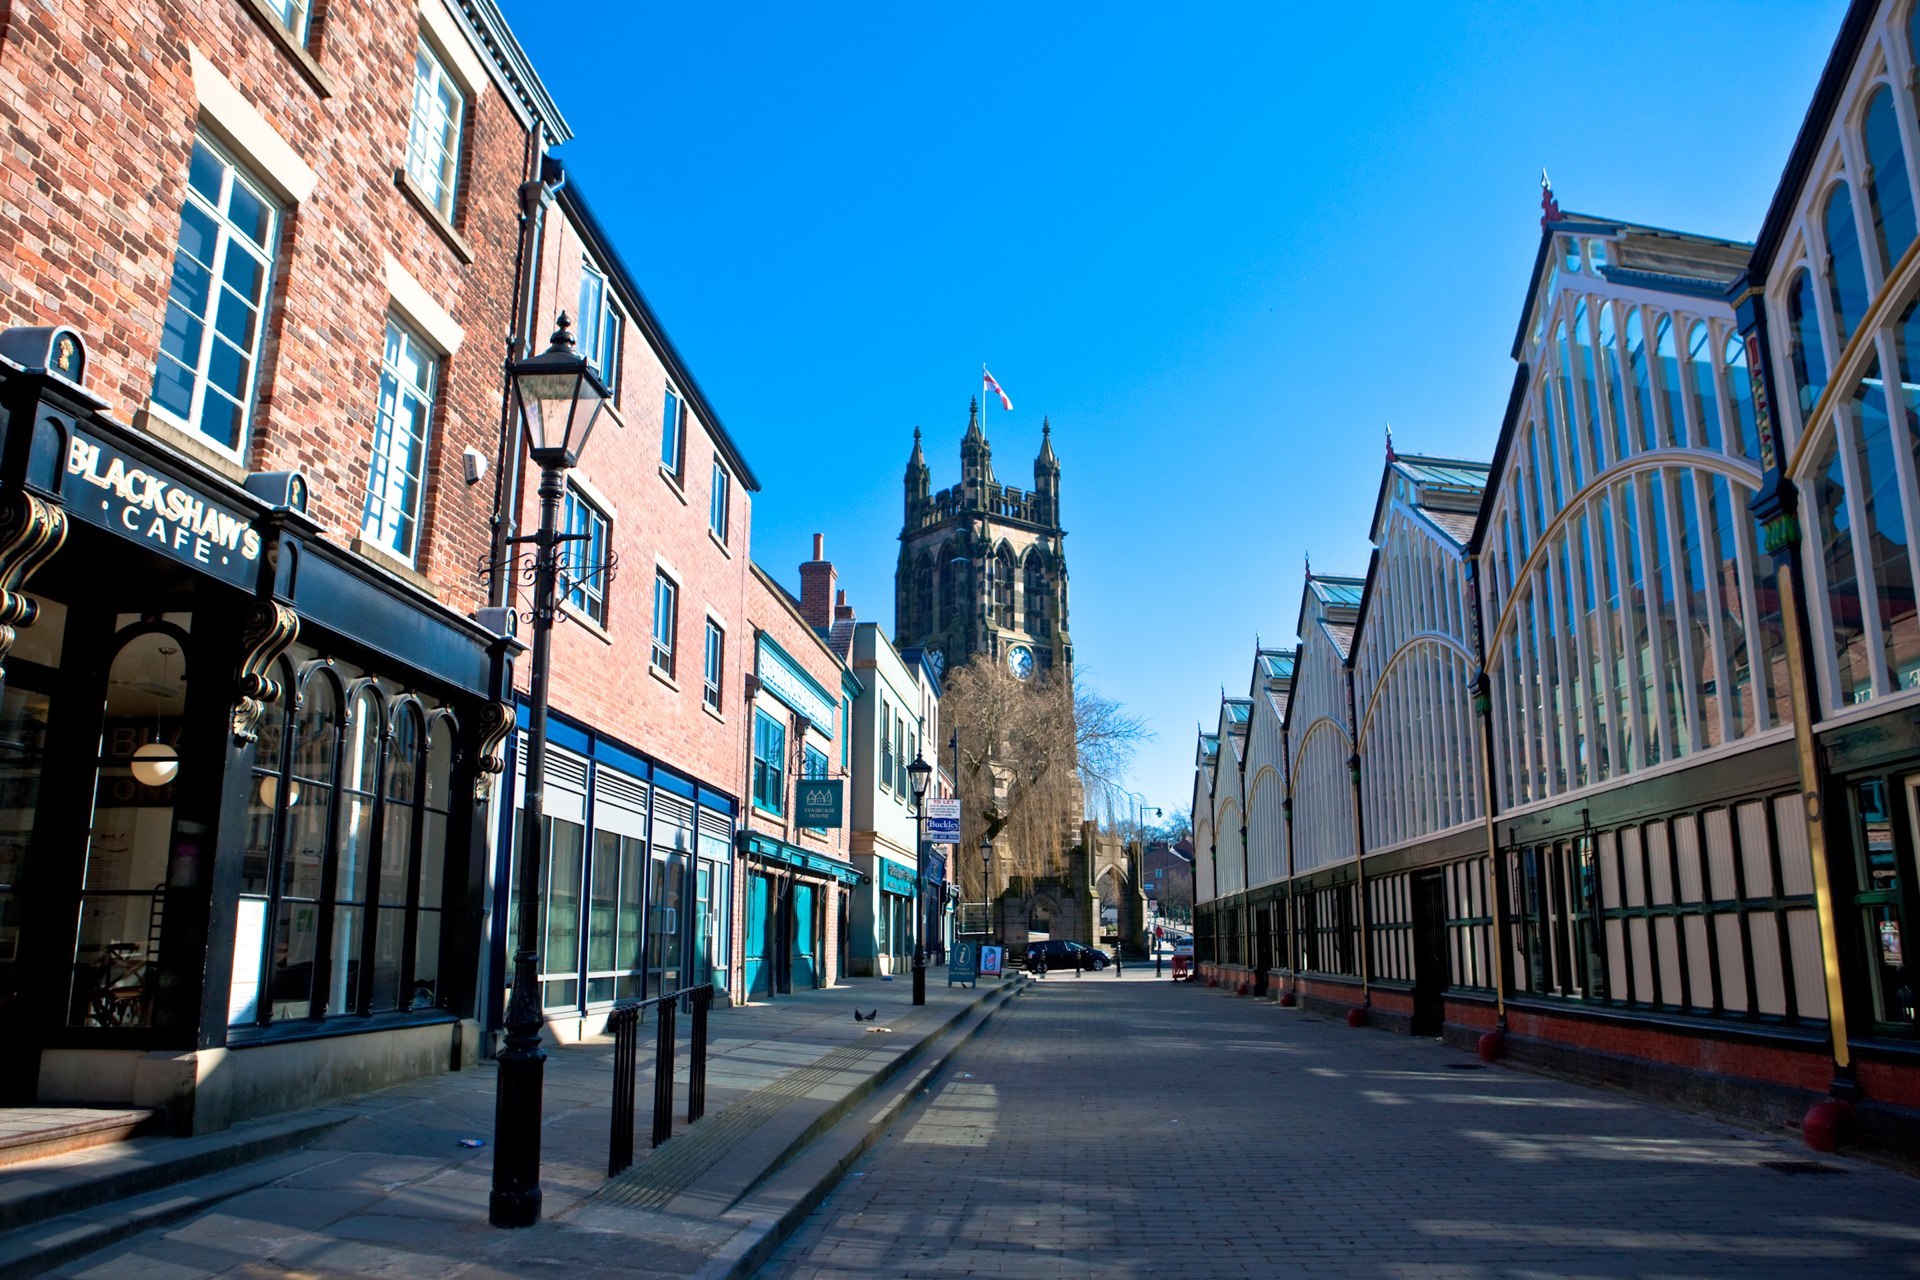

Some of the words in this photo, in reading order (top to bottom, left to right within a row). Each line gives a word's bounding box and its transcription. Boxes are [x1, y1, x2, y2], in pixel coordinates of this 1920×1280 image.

[67, 436, 261, 560] BLACKSHAW'S
[122, 505, 211, 564] CAFE
[929, 820, 958, 830] Buckley
